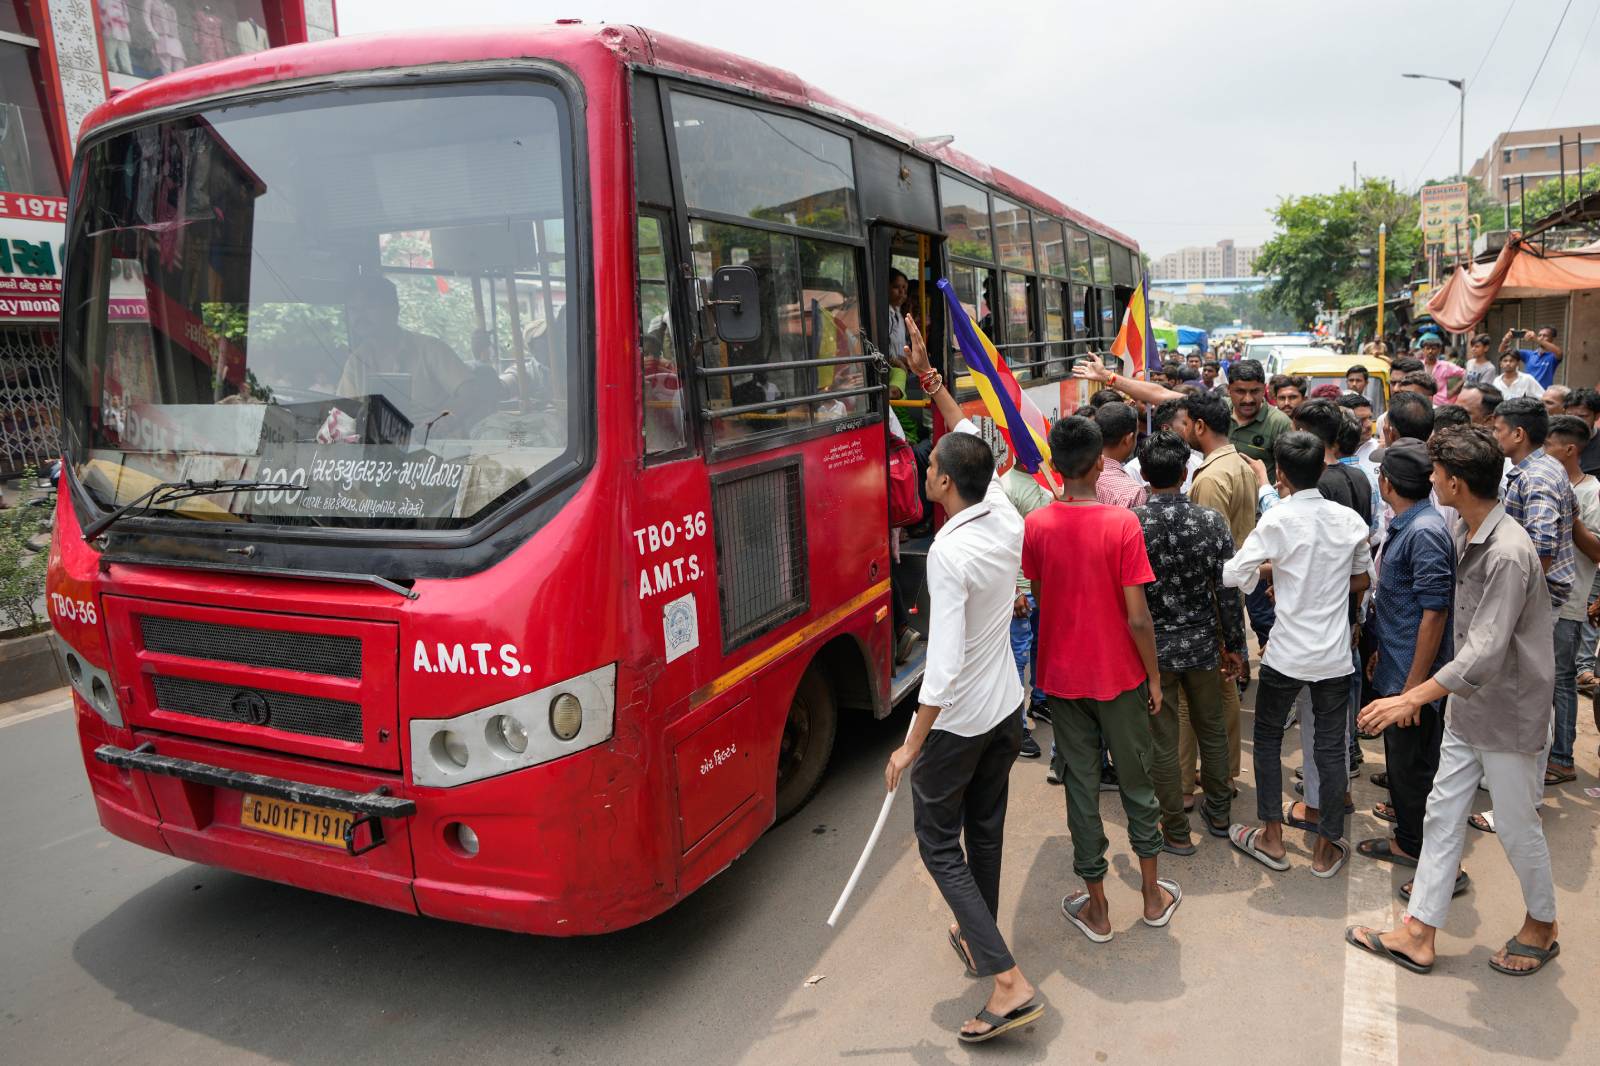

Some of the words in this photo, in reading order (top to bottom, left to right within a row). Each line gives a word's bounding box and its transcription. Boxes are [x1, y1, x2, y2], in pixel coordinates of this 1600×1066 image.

[15, 197, 68, 219] 1975
[0, 298, 60, 315] aymond
[639, 554, 705, 600] A.M.T.S.
[413, 639, 532, 677] A.M.T.S.
